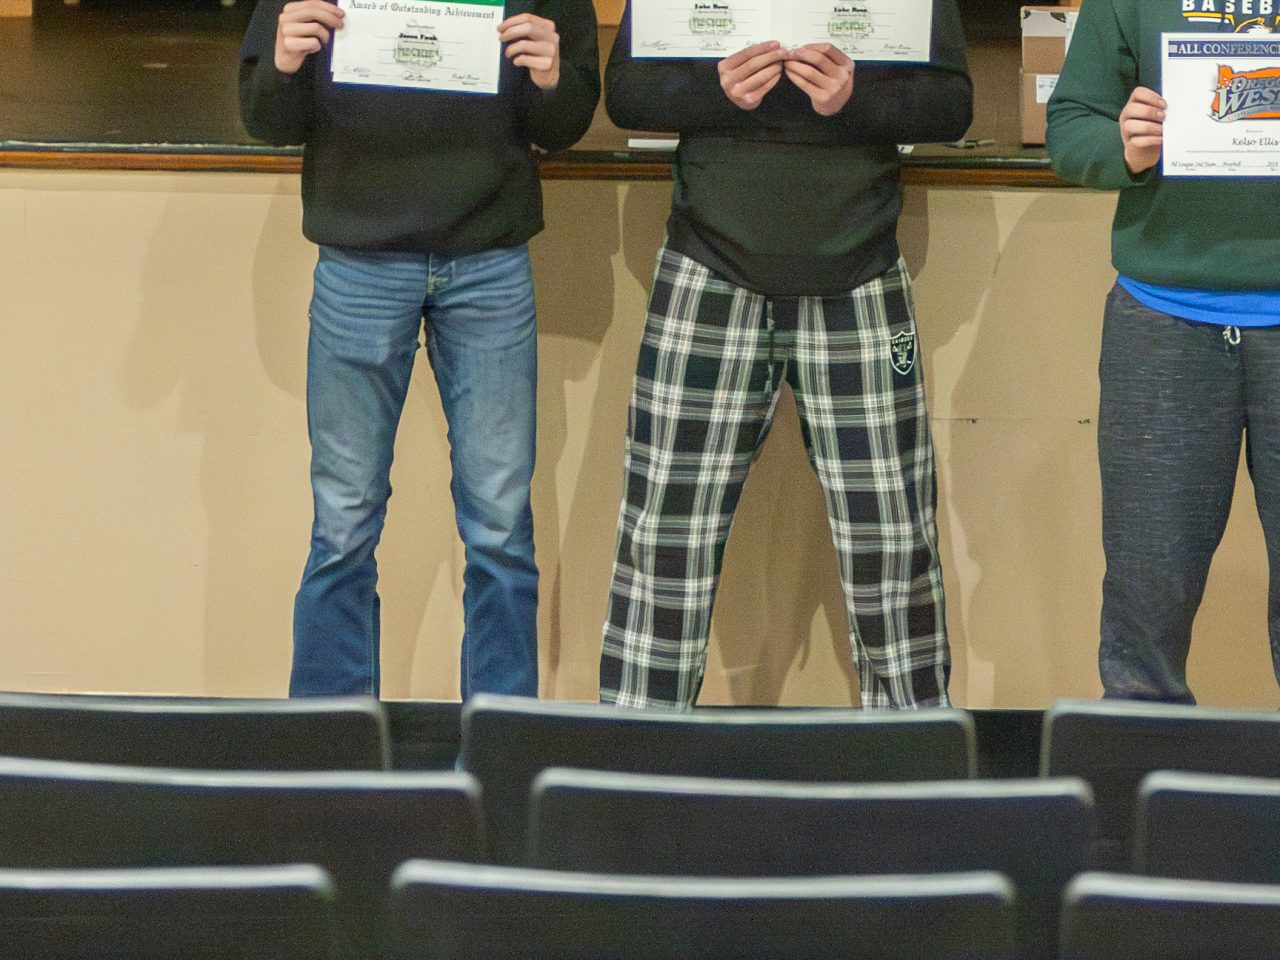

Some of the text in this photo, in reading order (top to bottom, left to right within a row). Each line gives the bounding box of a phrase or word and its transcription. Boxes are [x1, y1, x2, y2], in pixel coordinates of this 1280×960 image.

[349, 0, 495, 19] Award of Outstanding Achievement
[1177, 44, 1202, 54] ALL
[1232, 138, 1280, 146] Kelso Ellis
